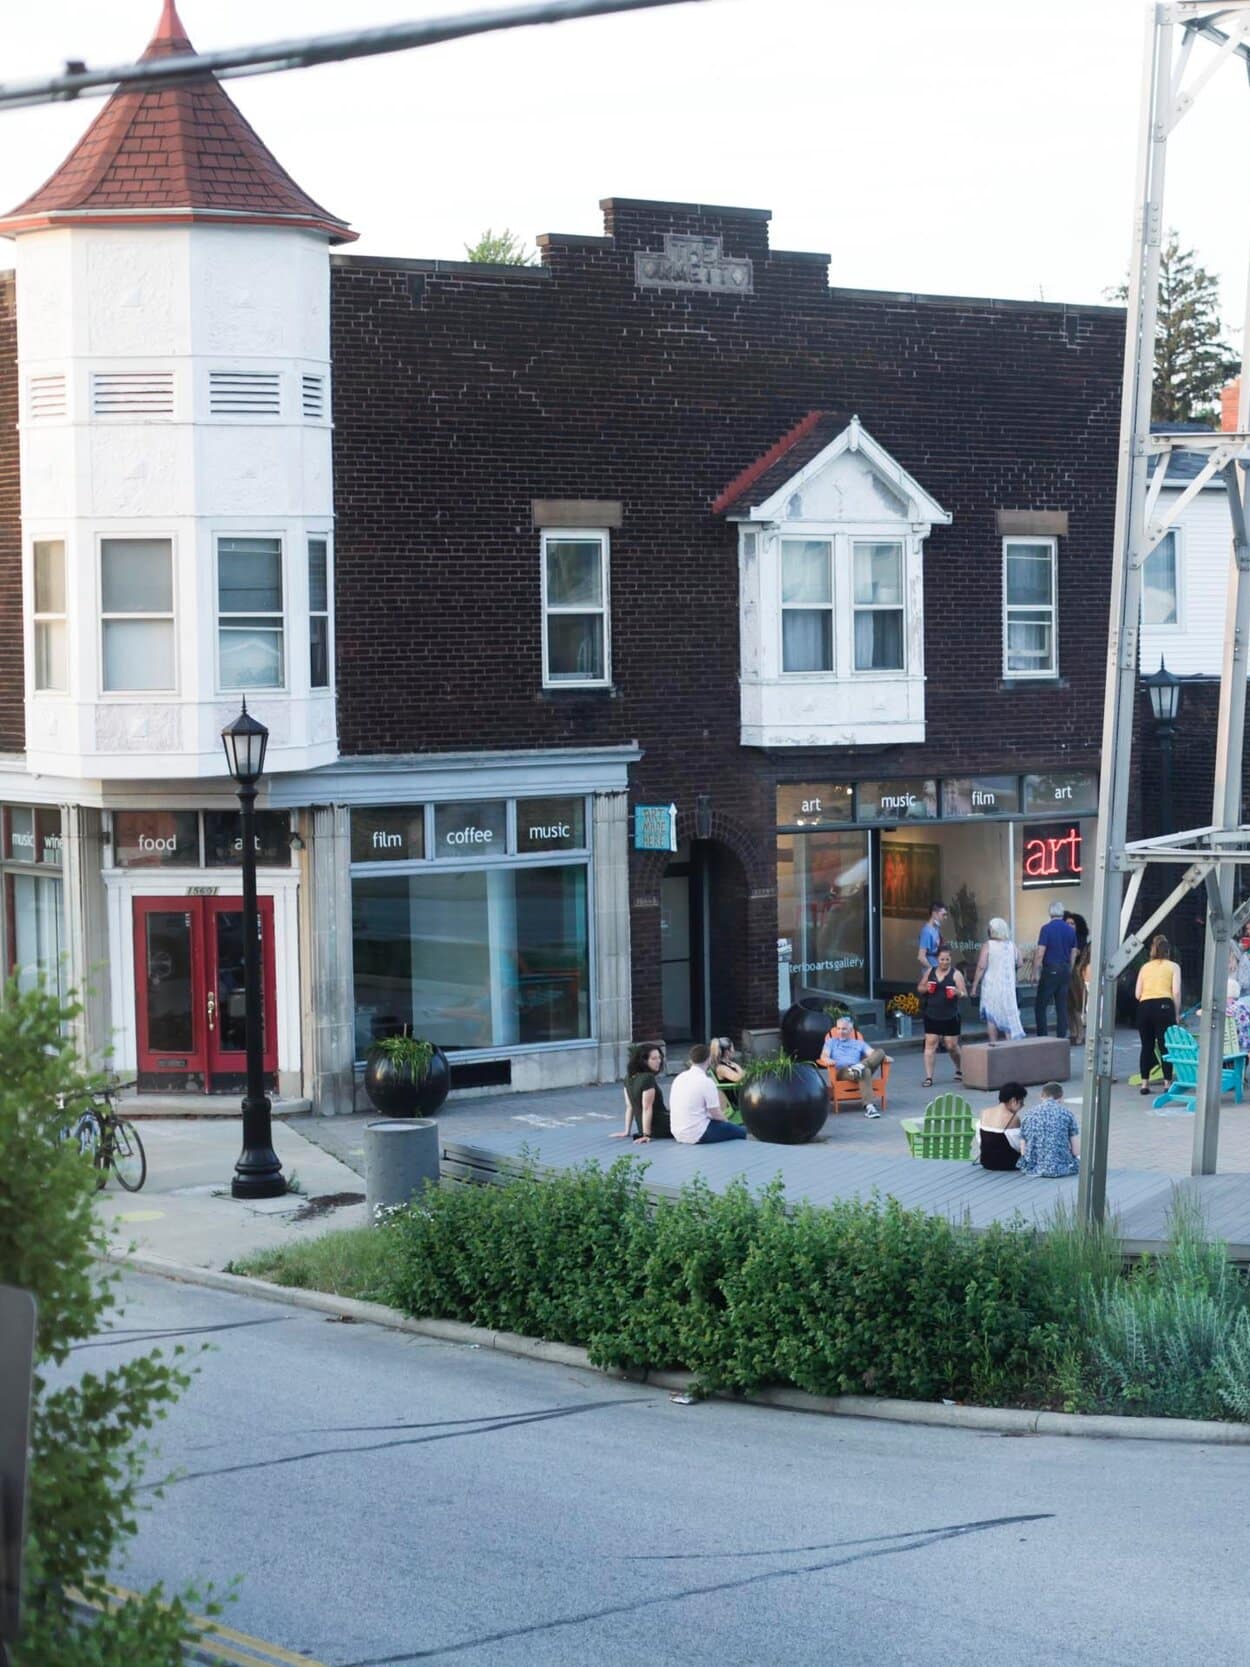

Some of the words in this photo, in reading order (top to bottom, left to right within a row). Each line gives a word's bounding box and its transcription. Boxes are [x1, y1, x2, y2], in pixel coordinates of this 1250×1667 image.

[801, 797, 822, 812] art
[881, 792, 917, 809] music
[972, 791, 995, 806] film
[1054, 785, 1073, 799] art
[12, 832, 35, 847] music
[138, 834, 177, 851] food
[234, 836, 261, 850] at
[373, 831, 402, 848] film
[446, 826, 493, 845] coffee
[529, 822, 571, 840] music
[1026, 828, 1083, 875] art
